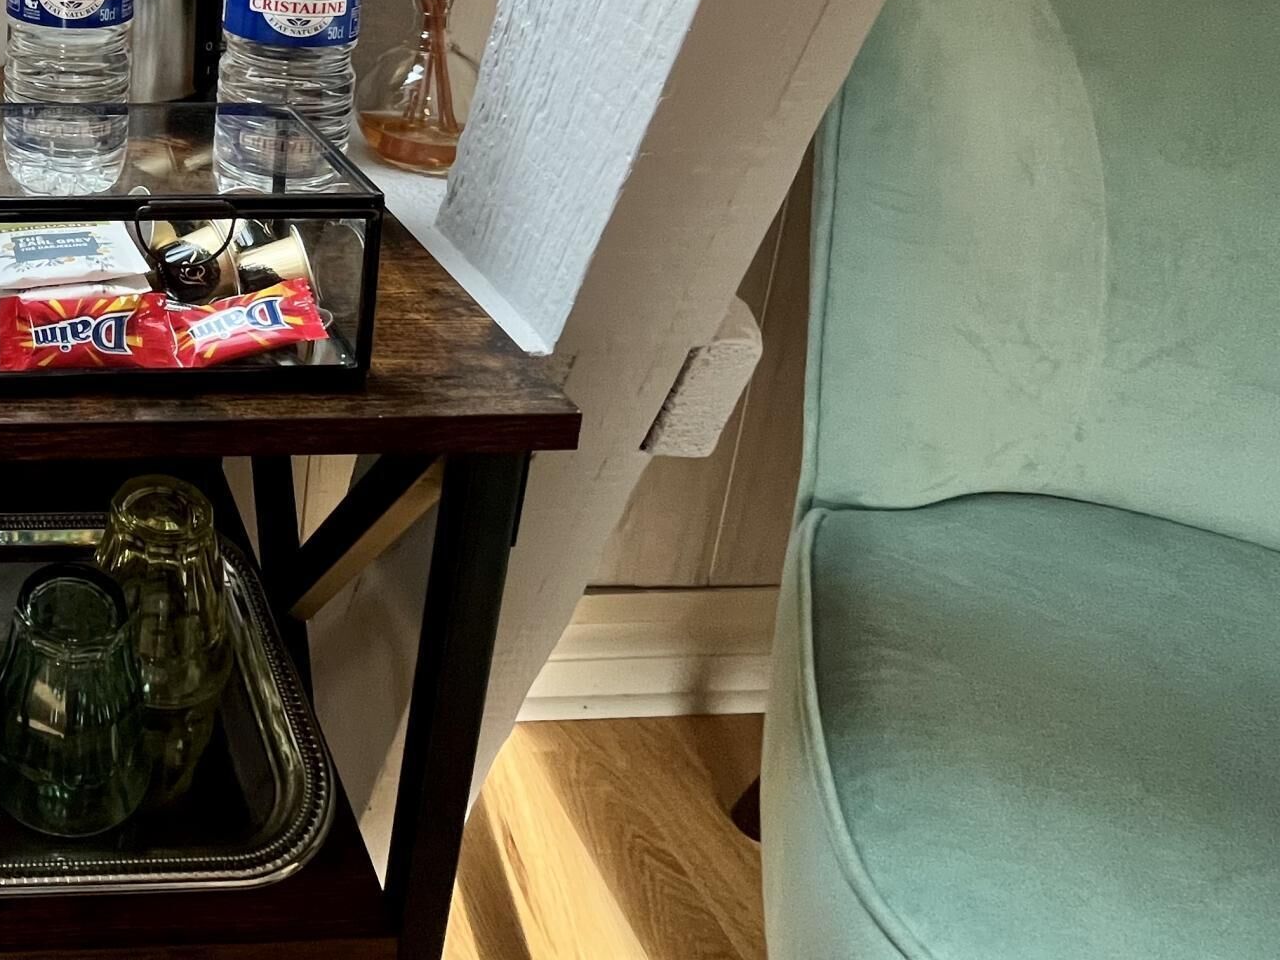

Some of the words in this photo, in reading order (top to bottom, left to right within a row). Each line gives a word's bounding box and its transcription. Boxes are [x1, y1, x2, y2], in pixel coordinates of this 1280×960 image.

[290, 20, 328, 35] NATUREL
[33, 310, 132, 355] Daim
[190, 297, 293, 340] Daim
